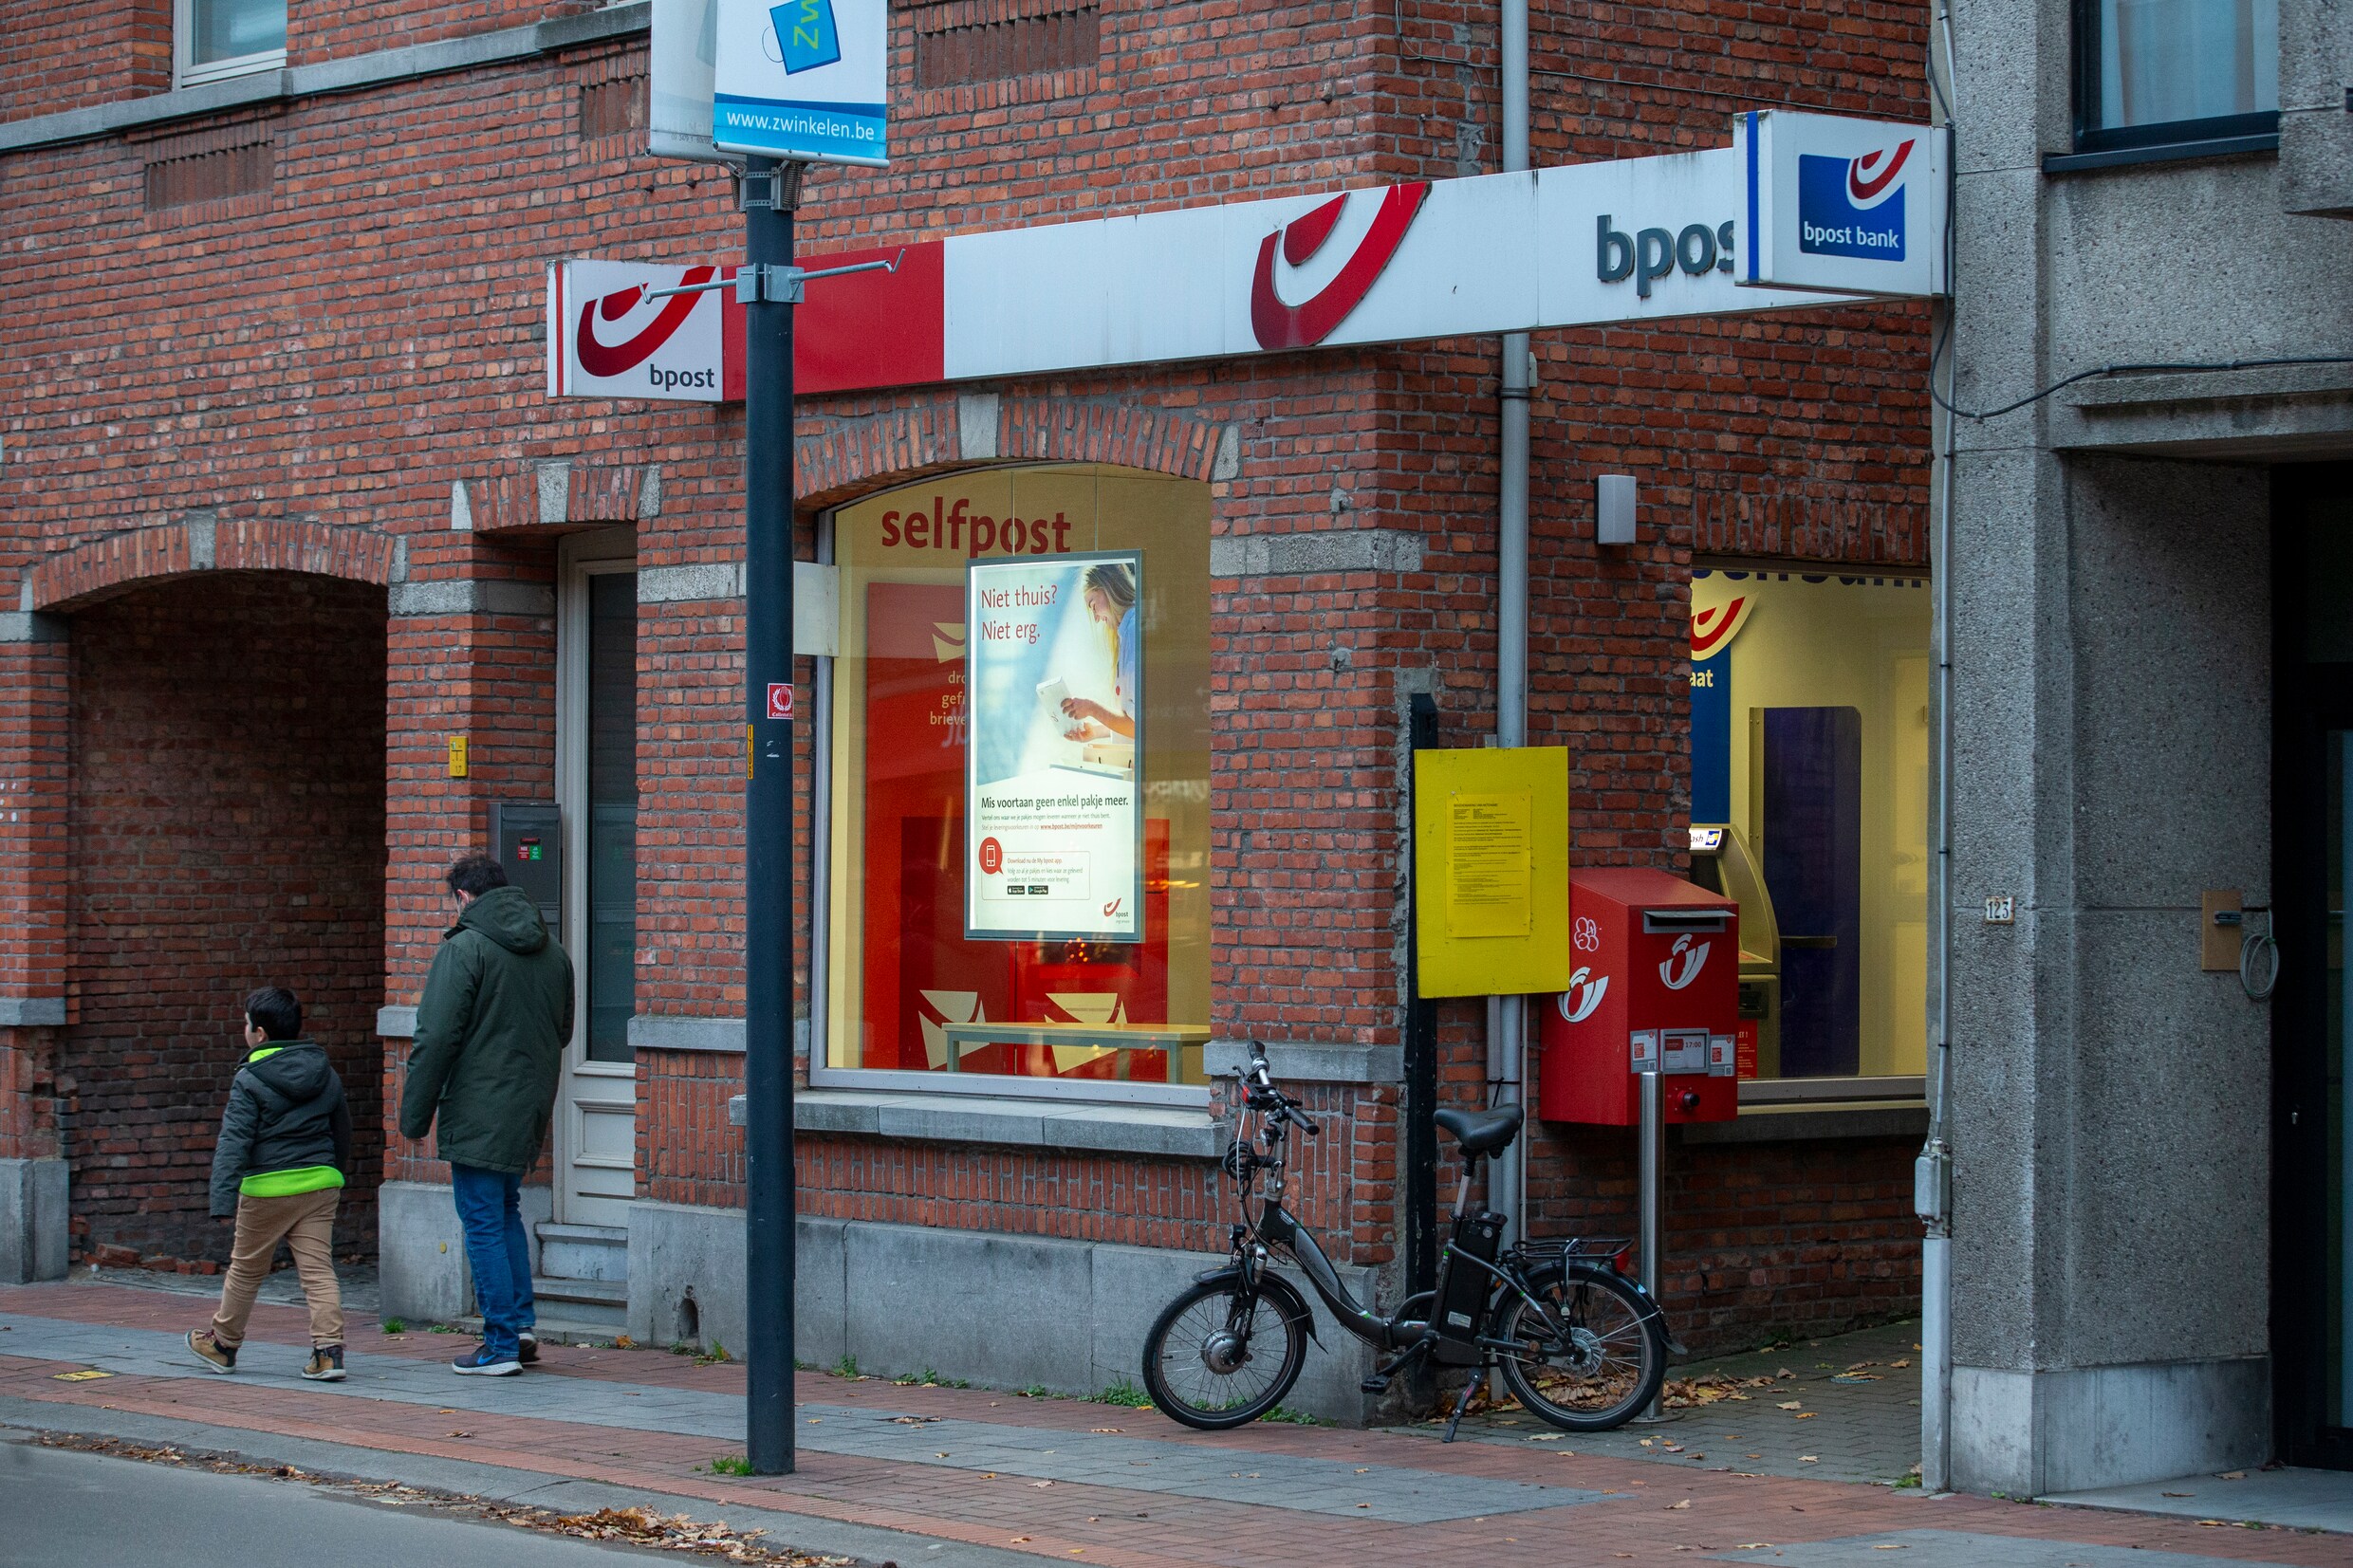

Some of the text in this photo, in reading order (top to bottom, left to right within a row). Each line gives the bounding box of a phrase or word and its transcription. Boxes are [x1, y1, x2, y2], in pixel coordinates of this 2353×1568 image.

[727, 111, 875, 140] www.zwinkelen.be
[1803, 221, 1899, 249] bpost bank
[650, 363, 715, 392] bpost
[881, 496, 1071, 558] selfpost
[981, 584, 1058, 609] Niet thuis?
[981, 620, 1041, 645] Niet erg.
[981, 794, 1128, 810] Mis voortaan geen enkel pakje meer.
[1987, 900, 2010, 920] 123
